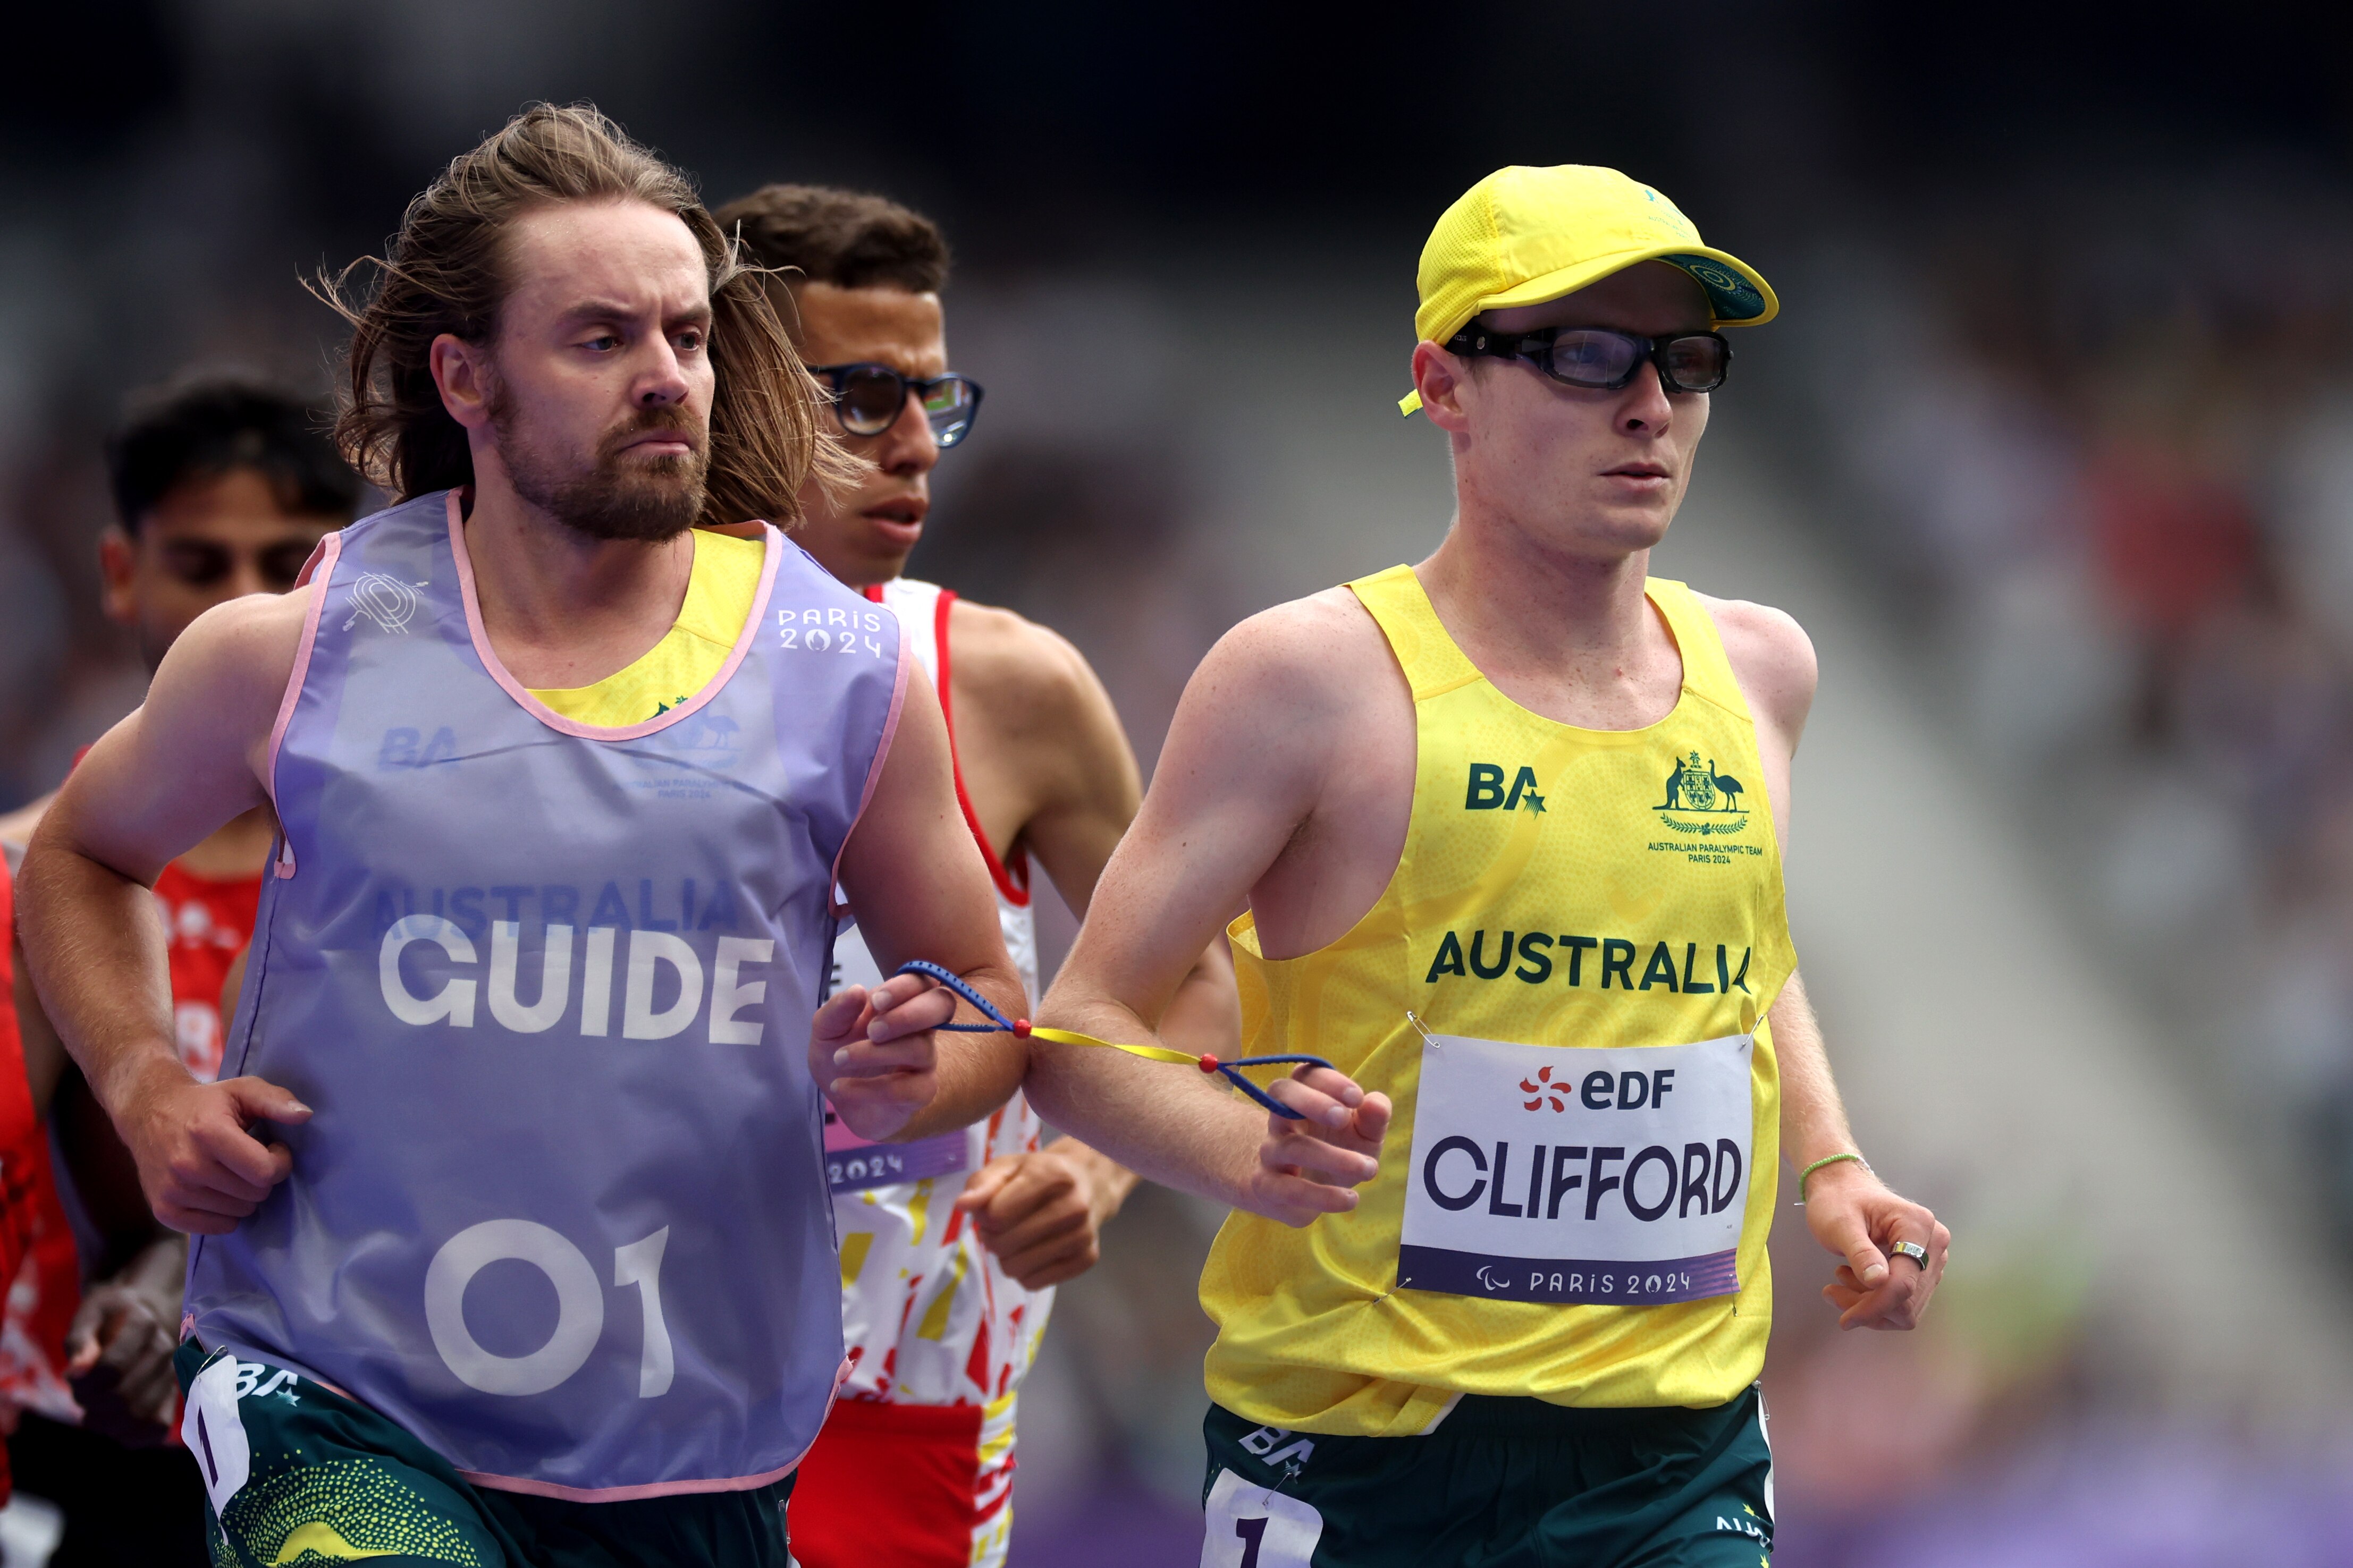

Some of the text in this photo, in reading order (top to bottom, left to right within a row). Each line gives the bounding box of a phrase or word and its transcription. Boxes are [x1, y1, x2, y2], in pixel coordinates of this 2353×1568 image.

[780, 628, 881, 659] 2024
[1465, 763, 1547, 820] BA
[1648, 842, 1762, 856] AUSTRALIAN PARALYMPIC TEAM
[1688, 854, 1731, 864] PARIS 2024
[379, 914, 775, 1046] GUIDE
[1426, 929, 1751, 995] AUSTRALIA
[829, 1154, 903, 1184] 2024
[1423, 1135, 1742, 1223] CLIFFORD
[425, 1218, 674, 1399] 01
[1626, 1272, 1690, 1294] 2024
[237, 1363, 301, 1408] BA
[1238, 1426, 1315, 1484] BA
